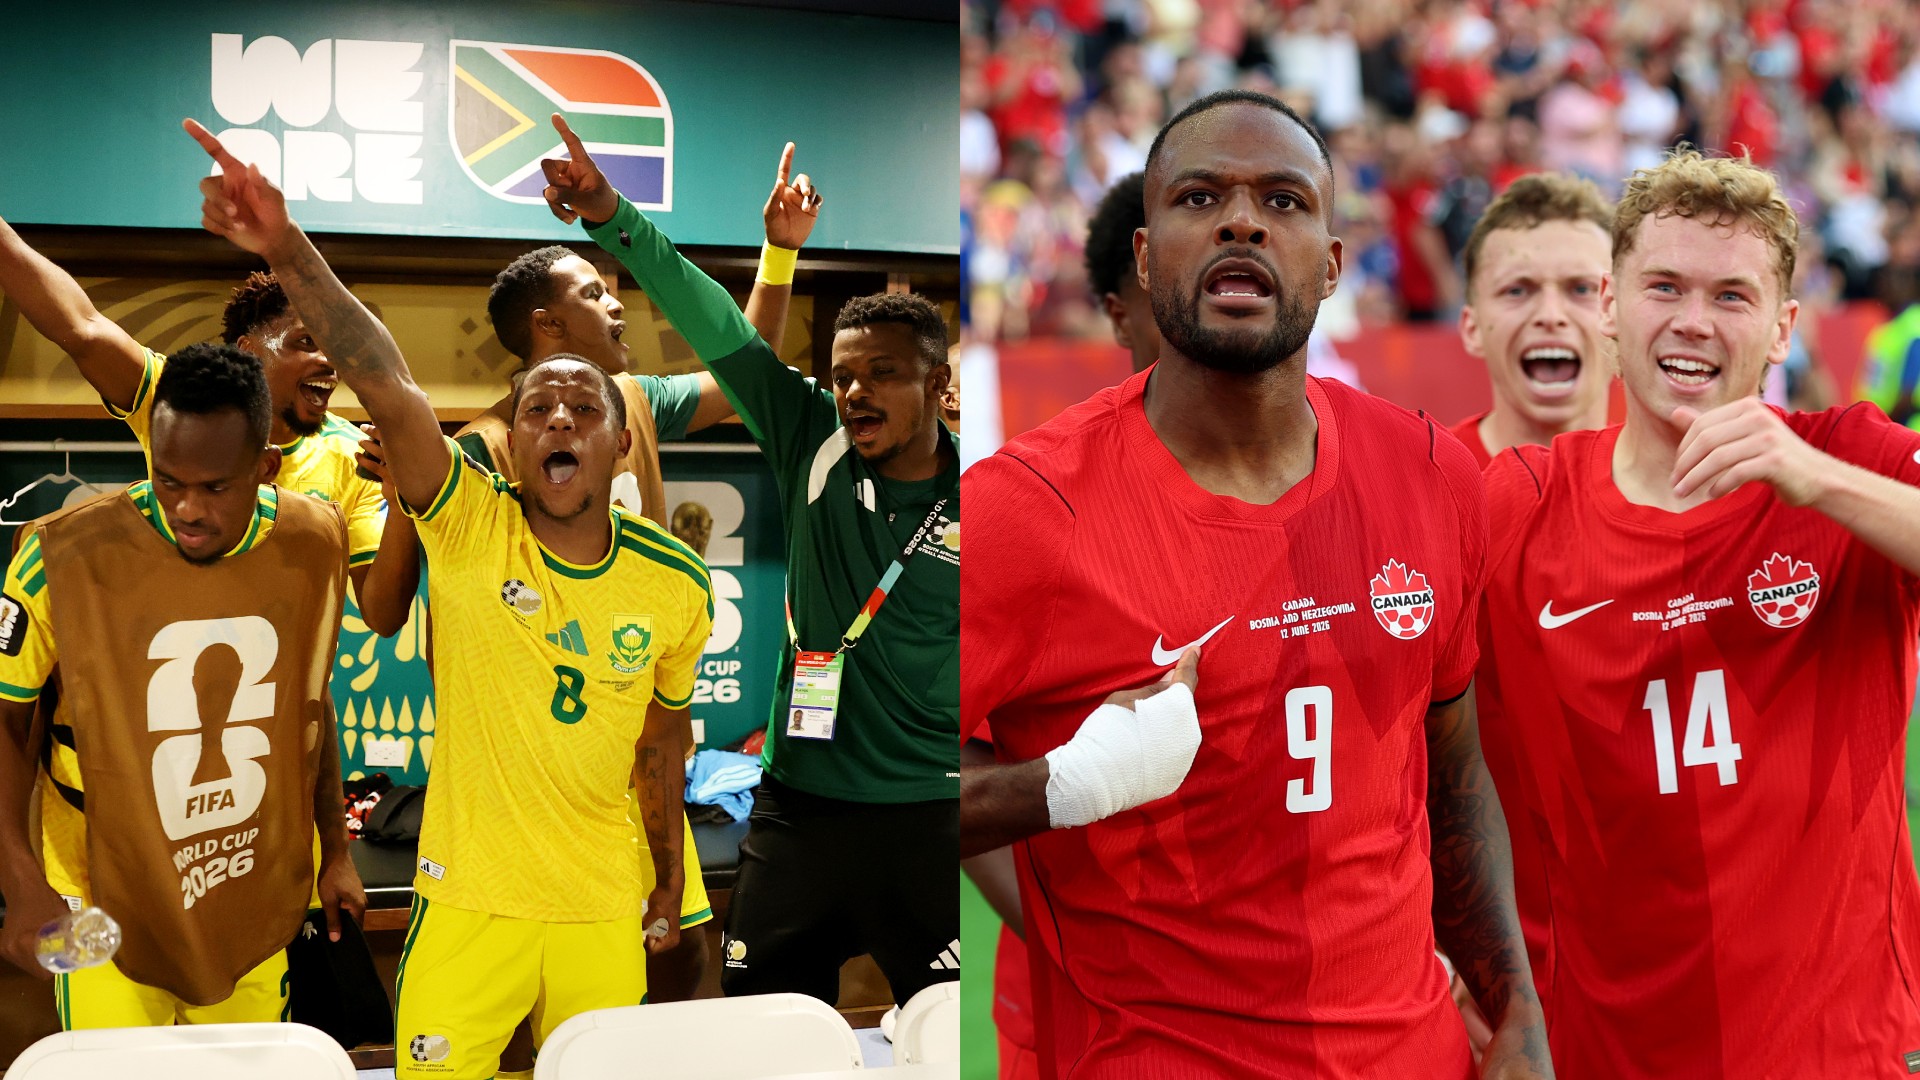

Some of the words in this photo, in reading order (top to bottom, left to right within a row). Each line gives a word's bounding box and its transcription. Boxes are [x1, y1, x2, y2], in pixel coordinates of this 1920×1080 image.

[211, 33, 424, 132] WE
[923, 511, 937, 528] CUP
[903, 526, 926, 556] 2026
[1282, 596, 1316, 611] CANADA
[1372, 593, 1433, 610] CANADA
[1667, 593, 1695, 609] CANADA
[1750, 579, 1817, 604] CANADA
[1250, 616, 1281, 631] BOSNIA
[1282, 612, 1299, 625] AND
[1301, 602, 1356, 621] HERZEGOVINA
[1632, 612, 1663, 622] BOSNIA
[1665, 608, 1681, 620] AND
[1681, 597, 1734, 617] HERZEGOVINA
[1661, 621, 1670, 631] 12
[1670, 617, 1687, 629] JUNE
[1689, 612, 1707, 622] 2026
[1280, 629, 1289, 639] 12
[1291, 625, 1310, 637] JUNE
[1312, 620, 1331, 633] 2026
[704, 660, 742, 677] CUP
[551, 664, 588, 724] 8
[690, 678, 741, 703] 26
[1642, 669, 1742, 794] 14
[1285, 685, 1333, 814] 9
[185, 789, 235, 819] FIFA
[221, 827, 260, 851] CUP
[180, 849, 255, 910] 2026
